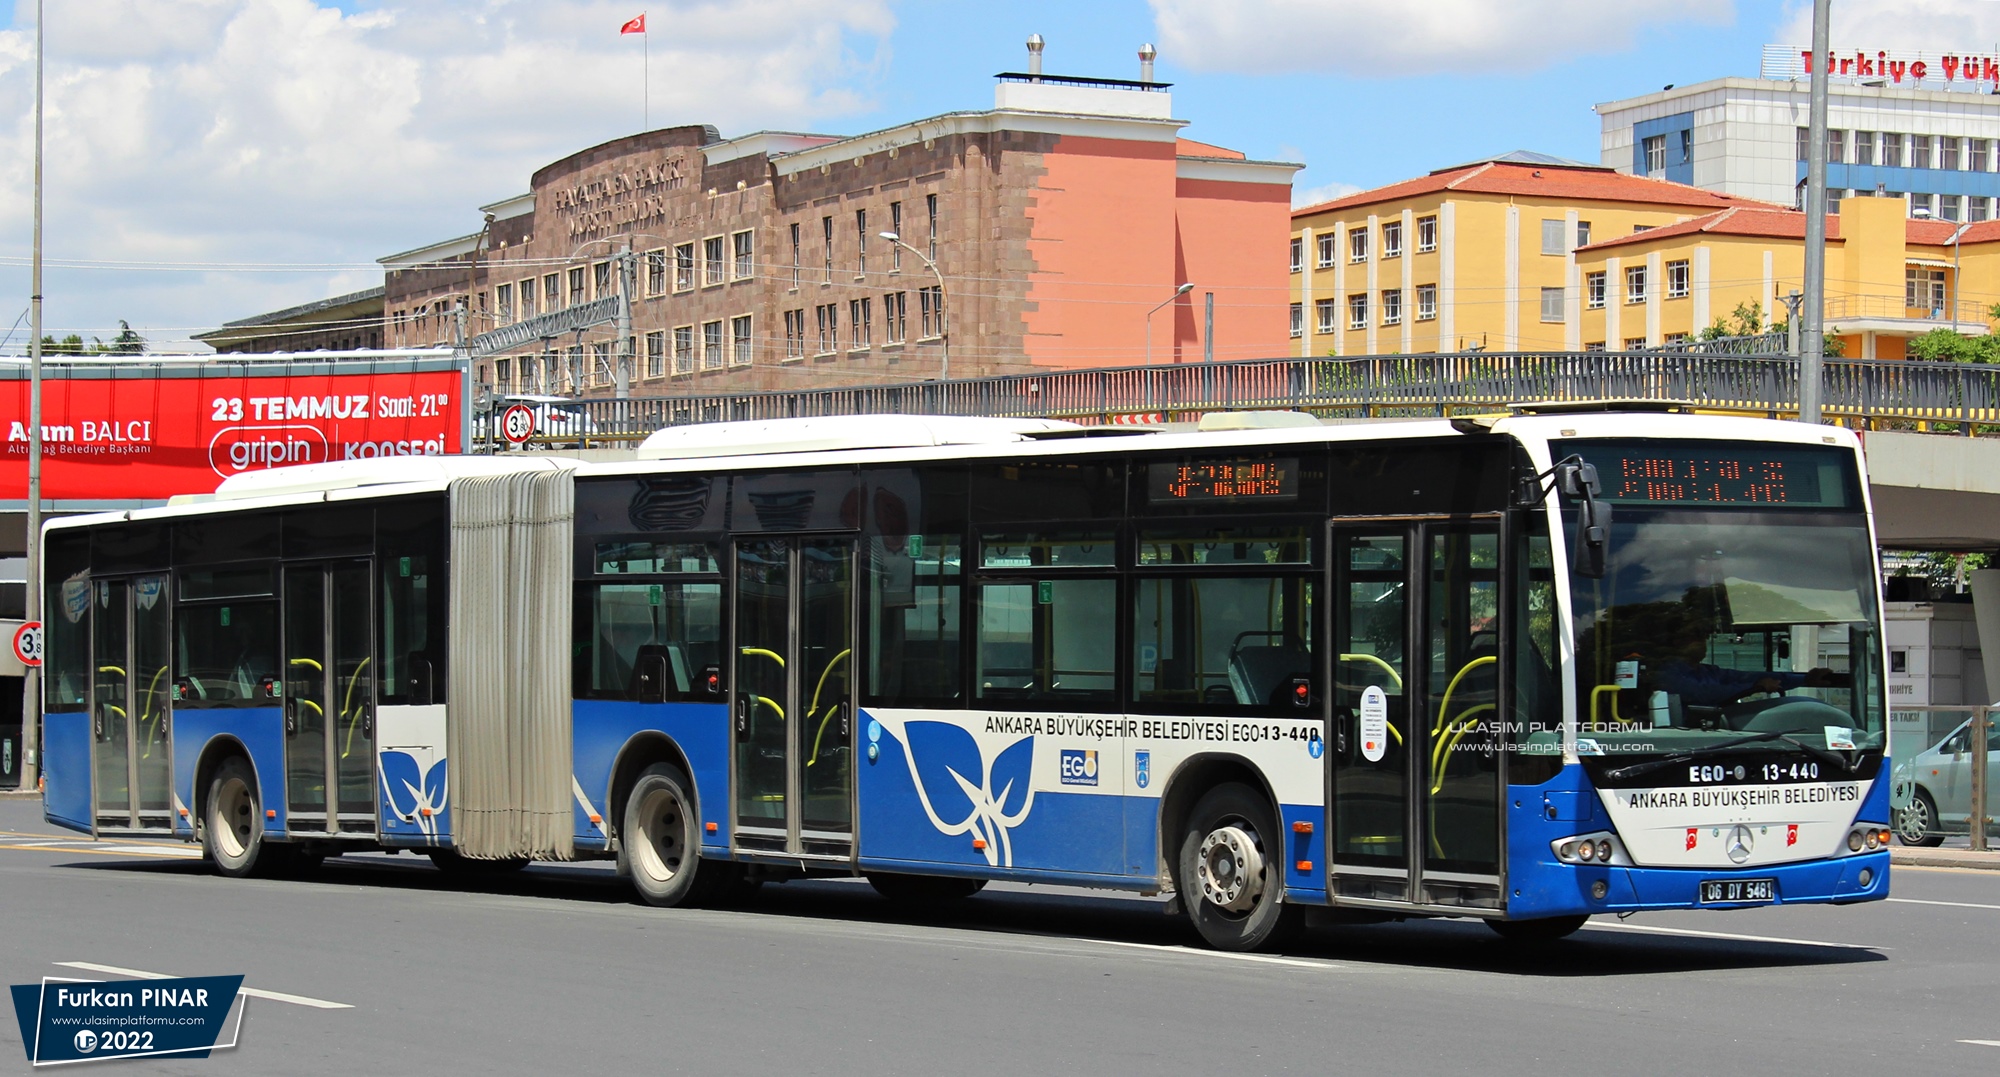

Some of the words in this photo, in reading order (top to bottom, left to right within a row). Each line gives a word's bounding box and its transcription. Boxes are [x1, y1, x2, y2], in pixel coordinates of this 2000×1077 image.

[211, 397, 244, 421] 23
[250, 395, 370, 420] TEMMUZ
[378, 396, 417, 418] Saat:
[8, 421, 75, 442] Aım
[81, 421, 151, 442] BALCI
[8, 445, 56, 455] Altıağ
[60, 445, 105, 455] Belediye
[109, 445, 151, 455] Başkanı
[229, 435, 311, 470] gripin
[985, 716, 1043, 735] ANKARA
[1047, 715, 1138, 742] BÜYÜKŞEHİR
[1142, 718, 1229, 741] BELEDİYESİ
[1062, 755, 1097, 777] EGO
[1762, 763, 1818, 781] 13-440
[1629, 793, 1688, 809] ANKARA
[1693, 787, 1780, 810] BÜYÜKŞEHİR
[1785, 783, 1859, 804] BELEDİYESİ
[1708, 884, 1722, 900] 06
[1728, 883, 1742, 899] DY
[1746, 882, 1772, 898] 5481
